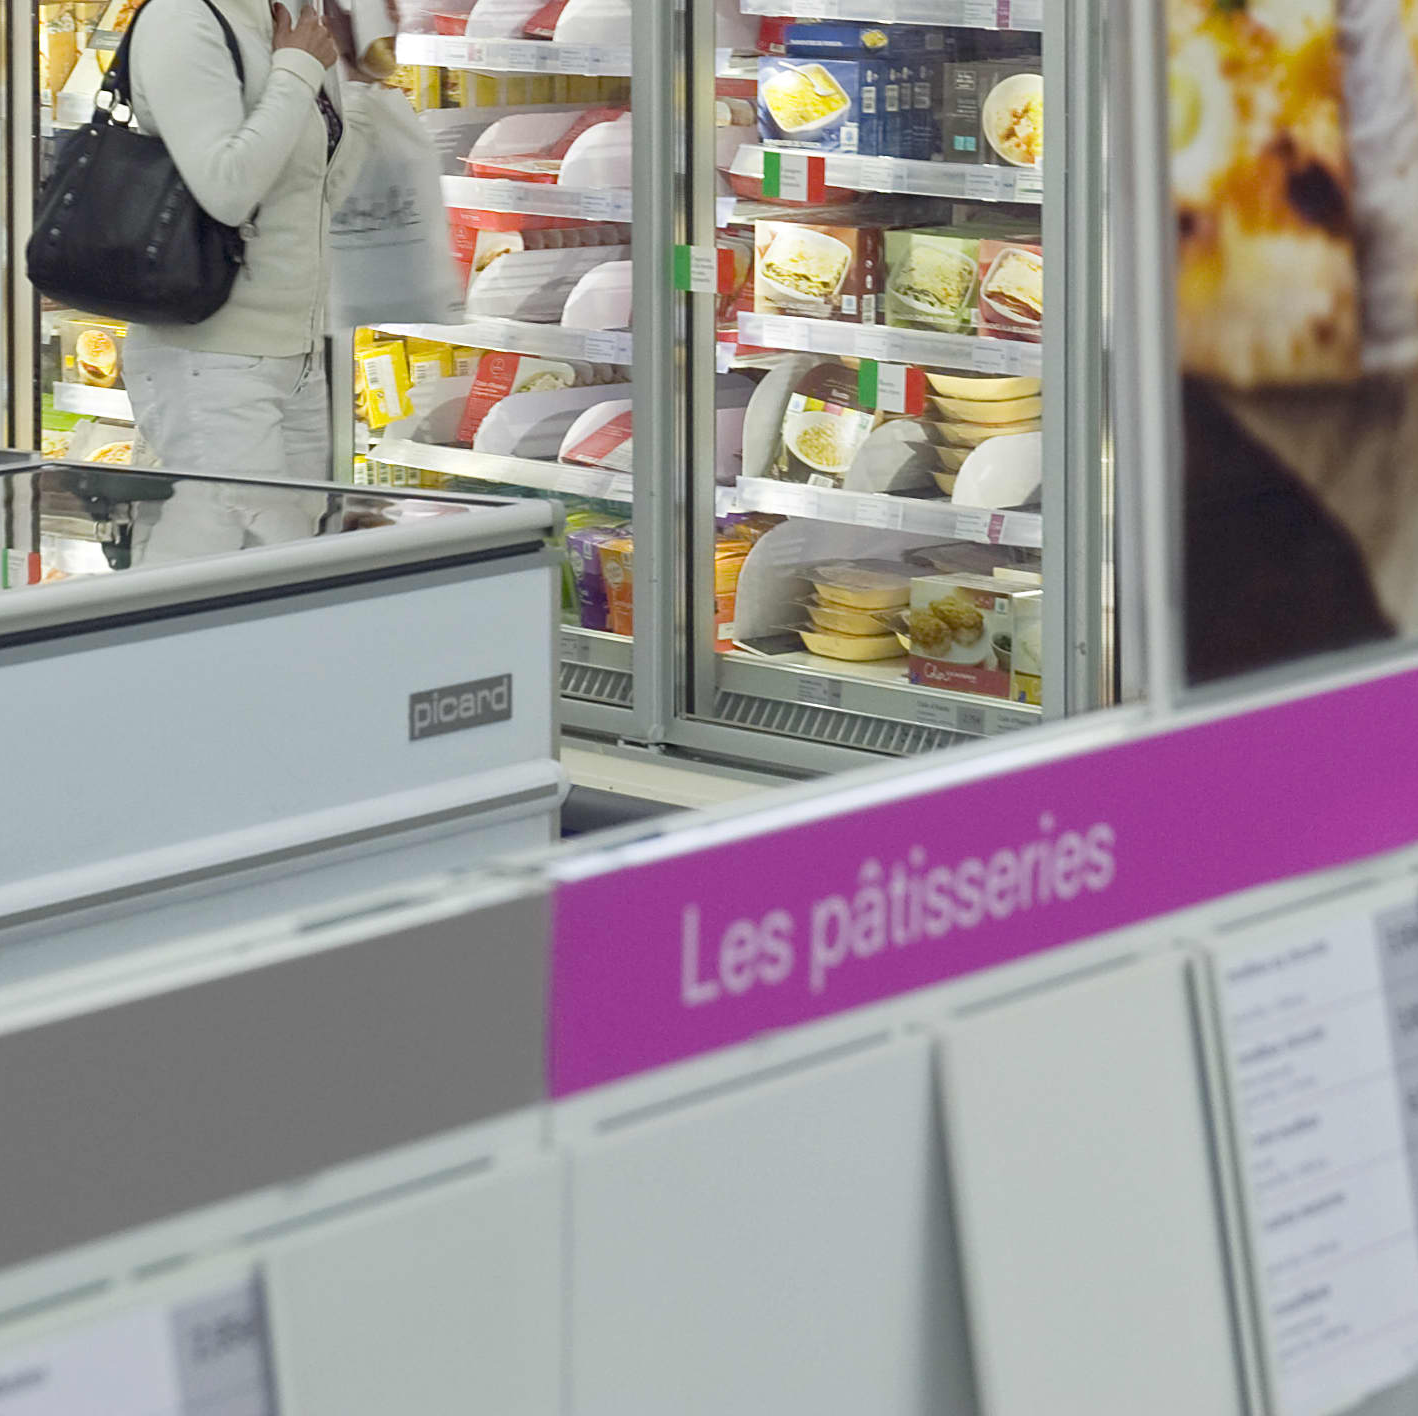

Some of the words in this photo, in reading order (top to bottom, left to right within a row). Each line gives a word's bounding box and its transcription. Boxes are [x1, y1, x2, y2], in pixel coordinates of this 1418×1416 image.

[413, 676, 508, 738] picard
[680, 900, 796, 1008] Les
[809, 810, 1118, 996] pâtisseries
